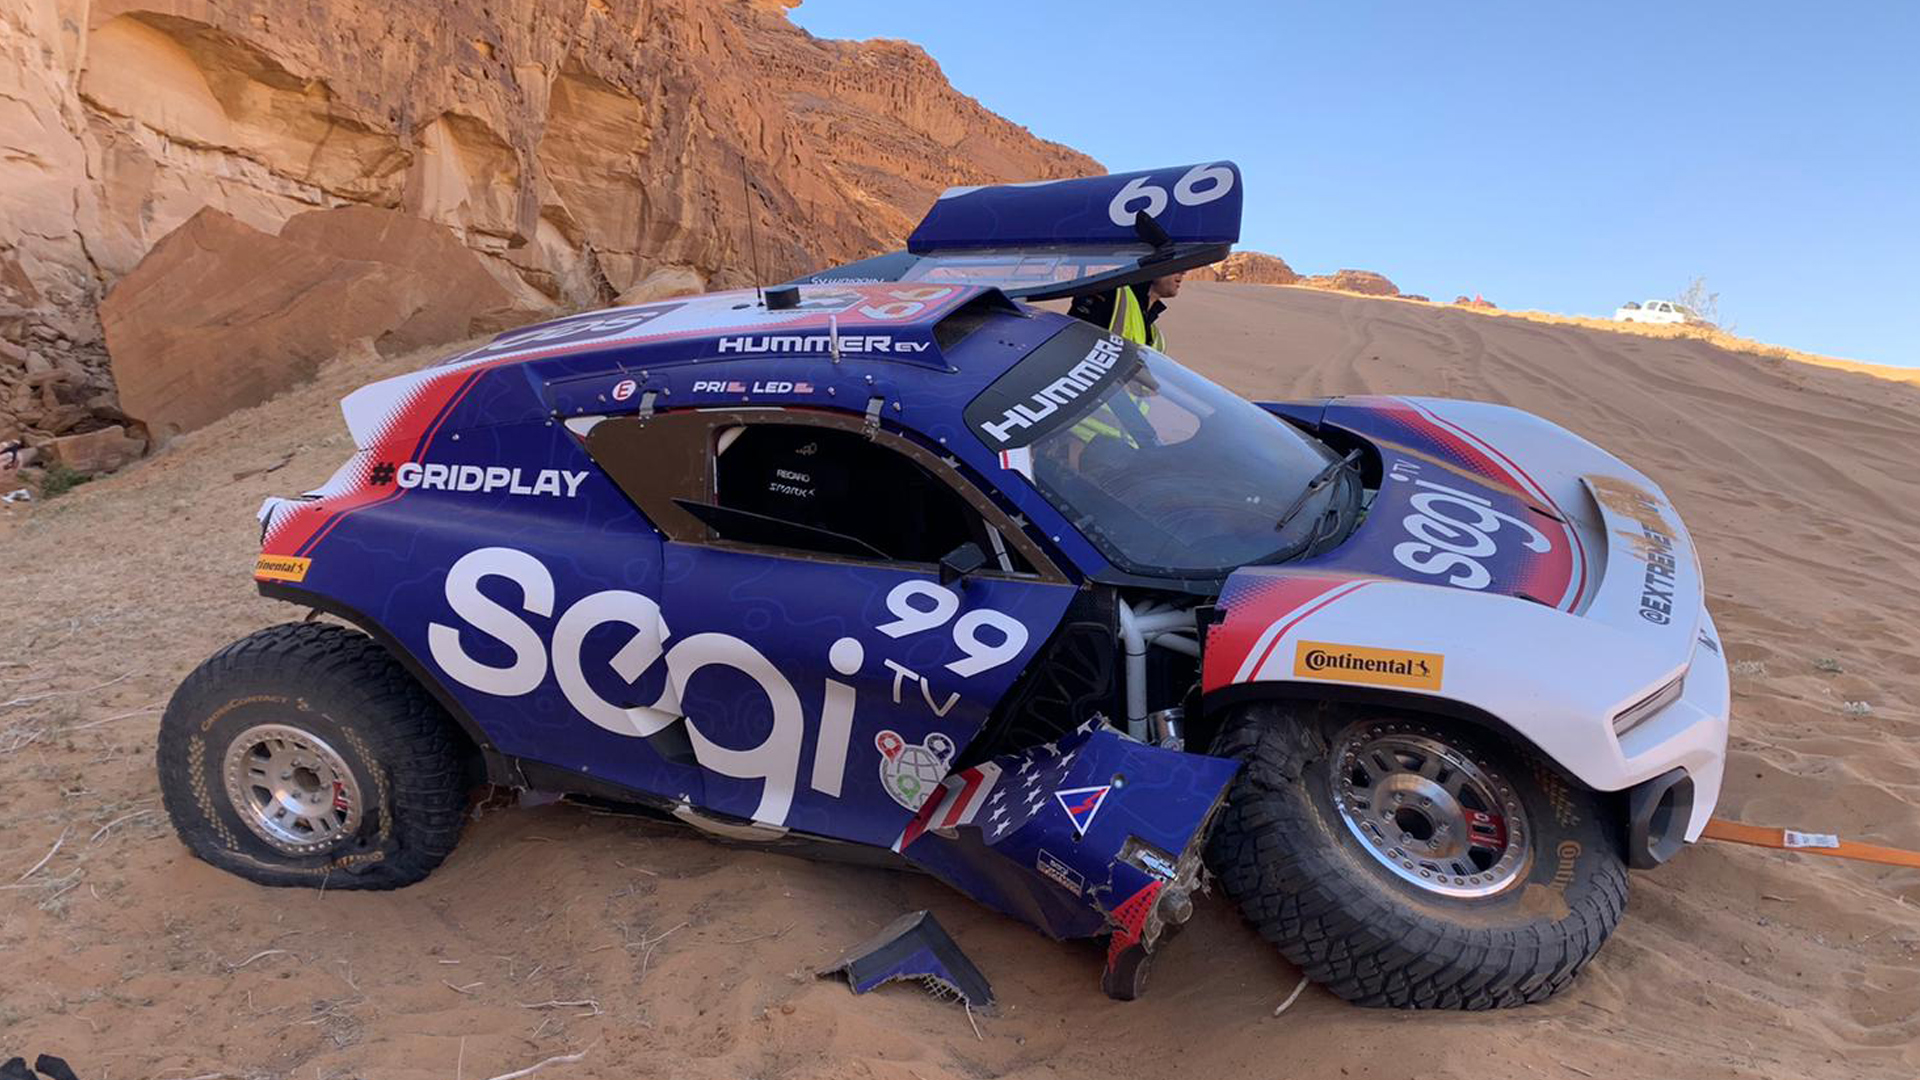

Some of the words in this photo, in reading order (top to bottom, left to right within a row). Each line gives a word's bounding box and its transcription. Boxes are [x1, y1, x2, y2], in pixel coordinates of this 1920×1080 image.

[718, 336, 891, 353] HUMMER
[895, 342, 931, 353] EV
[692, 381, 727, 393] PRI
[752, 381, 793, 394] LED
[980, 338, 1122, 443] HUMMER
[370, 462, 589, 497] #GRIDPLAY
[875, 579, 1029, 677] 99
[1305, 650, 1413, 675] Continental
[882, 658, 962, 718] TV
